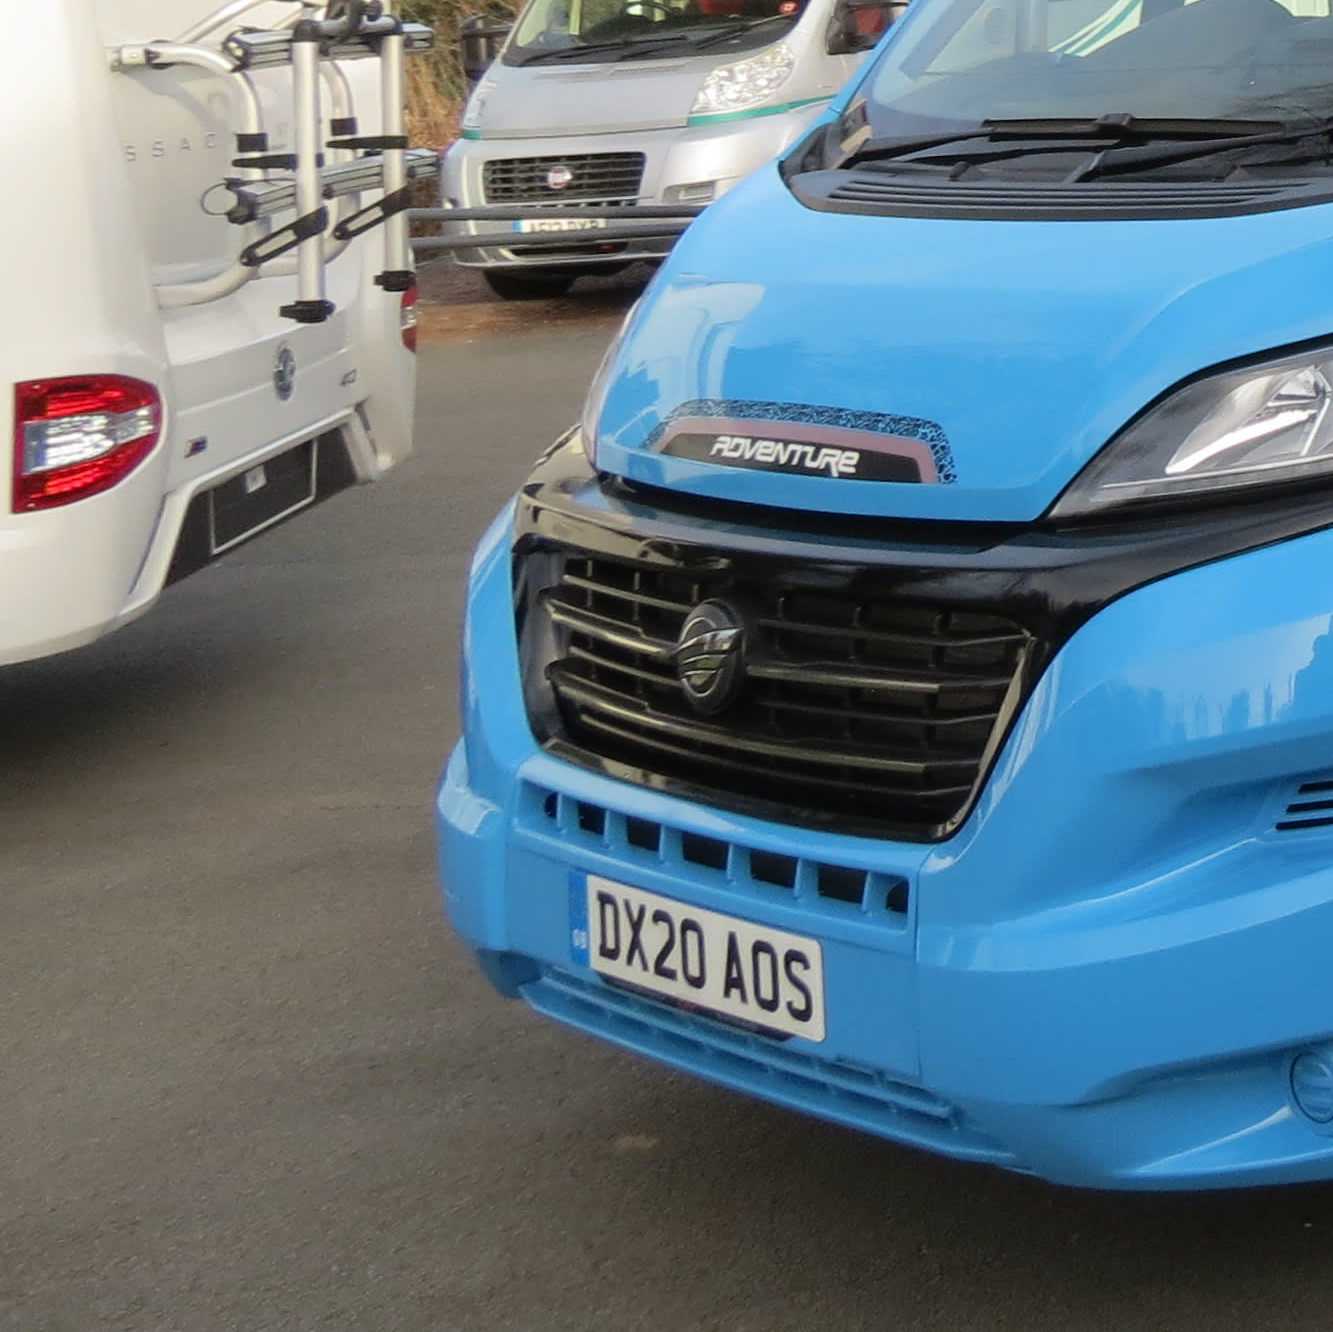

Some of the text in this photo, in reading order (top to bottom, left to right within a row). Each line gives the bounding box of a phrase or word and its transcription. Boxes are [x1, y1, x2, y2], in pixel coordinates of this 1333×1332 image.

[709, 435, 860, 477] ADVENTURE
[597, 889, 813, 1023] DX20 AOS
